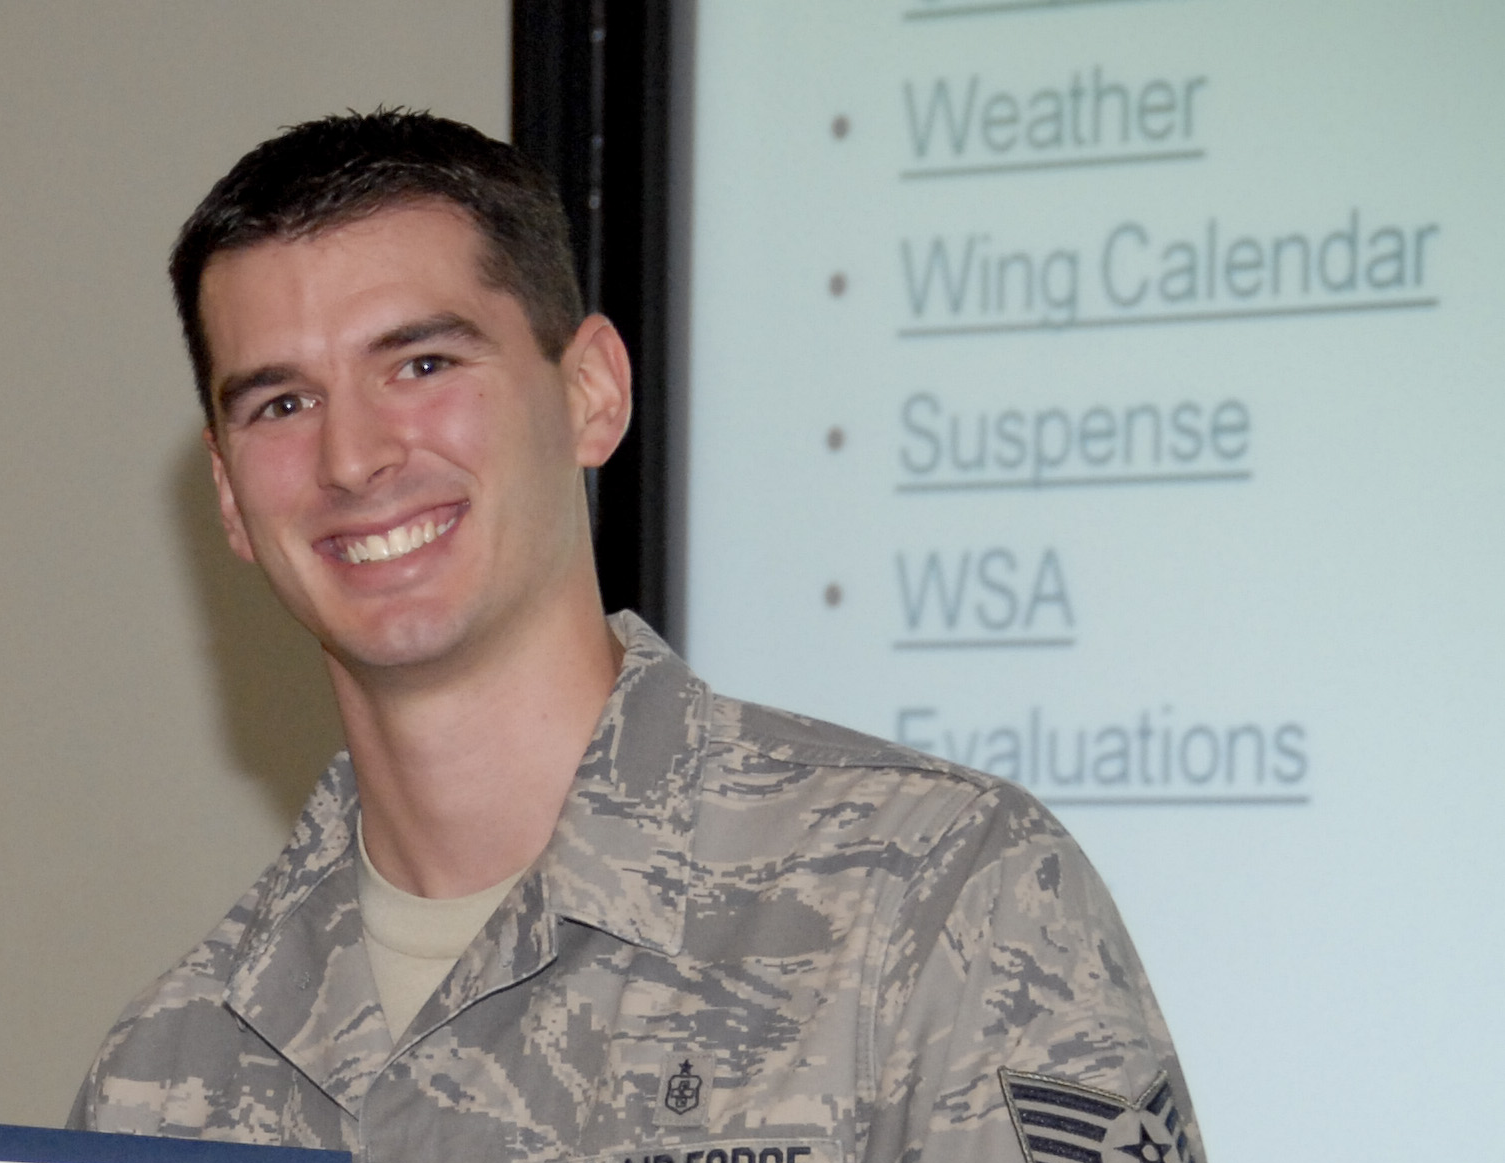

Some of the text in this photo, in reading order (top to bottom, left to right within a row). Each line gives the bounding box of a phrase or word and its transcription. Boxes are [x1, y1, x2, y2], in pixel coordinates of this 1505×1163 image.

[901, 65, 1209, 161] Weather
[900, 206, 1442, 332] Wing Calendar
[898, 392, 1254, 489] Suspense
[894, 545, 1076, 633] WSA
